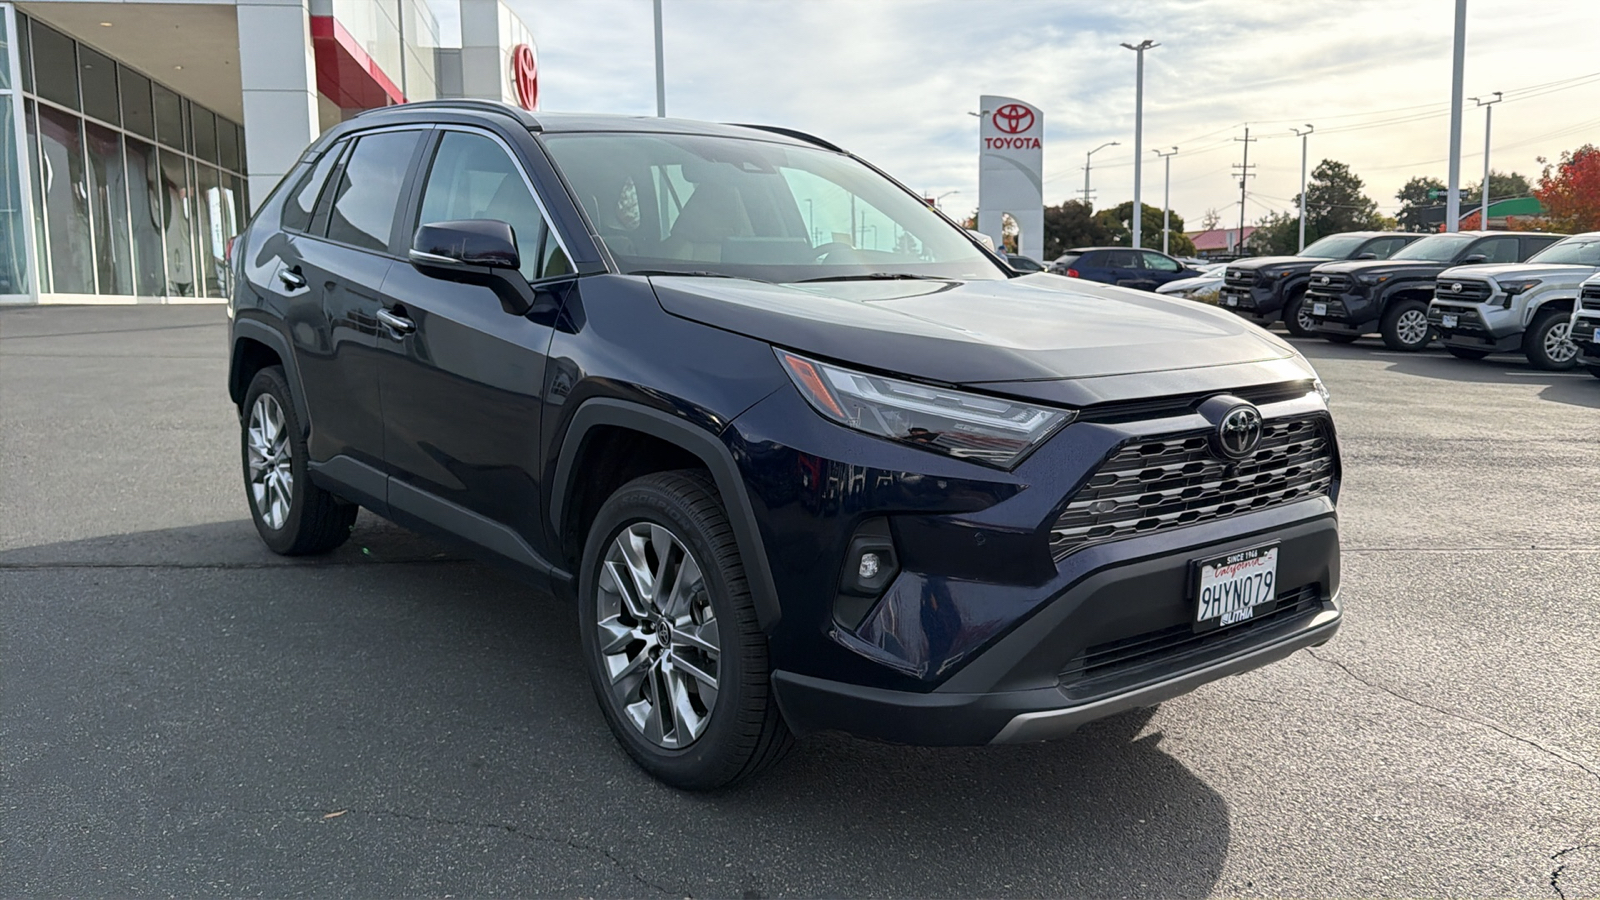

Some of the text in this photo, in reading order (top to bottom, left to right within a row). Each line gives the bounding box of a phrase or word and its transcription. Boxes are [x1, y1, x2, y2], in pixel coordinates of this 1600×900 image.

[984, 137, 1042, 150] TOYOTA
[1226, 552, 1244, 565] SINCE
[1200, 570, 1274, 620] 9HYN079
